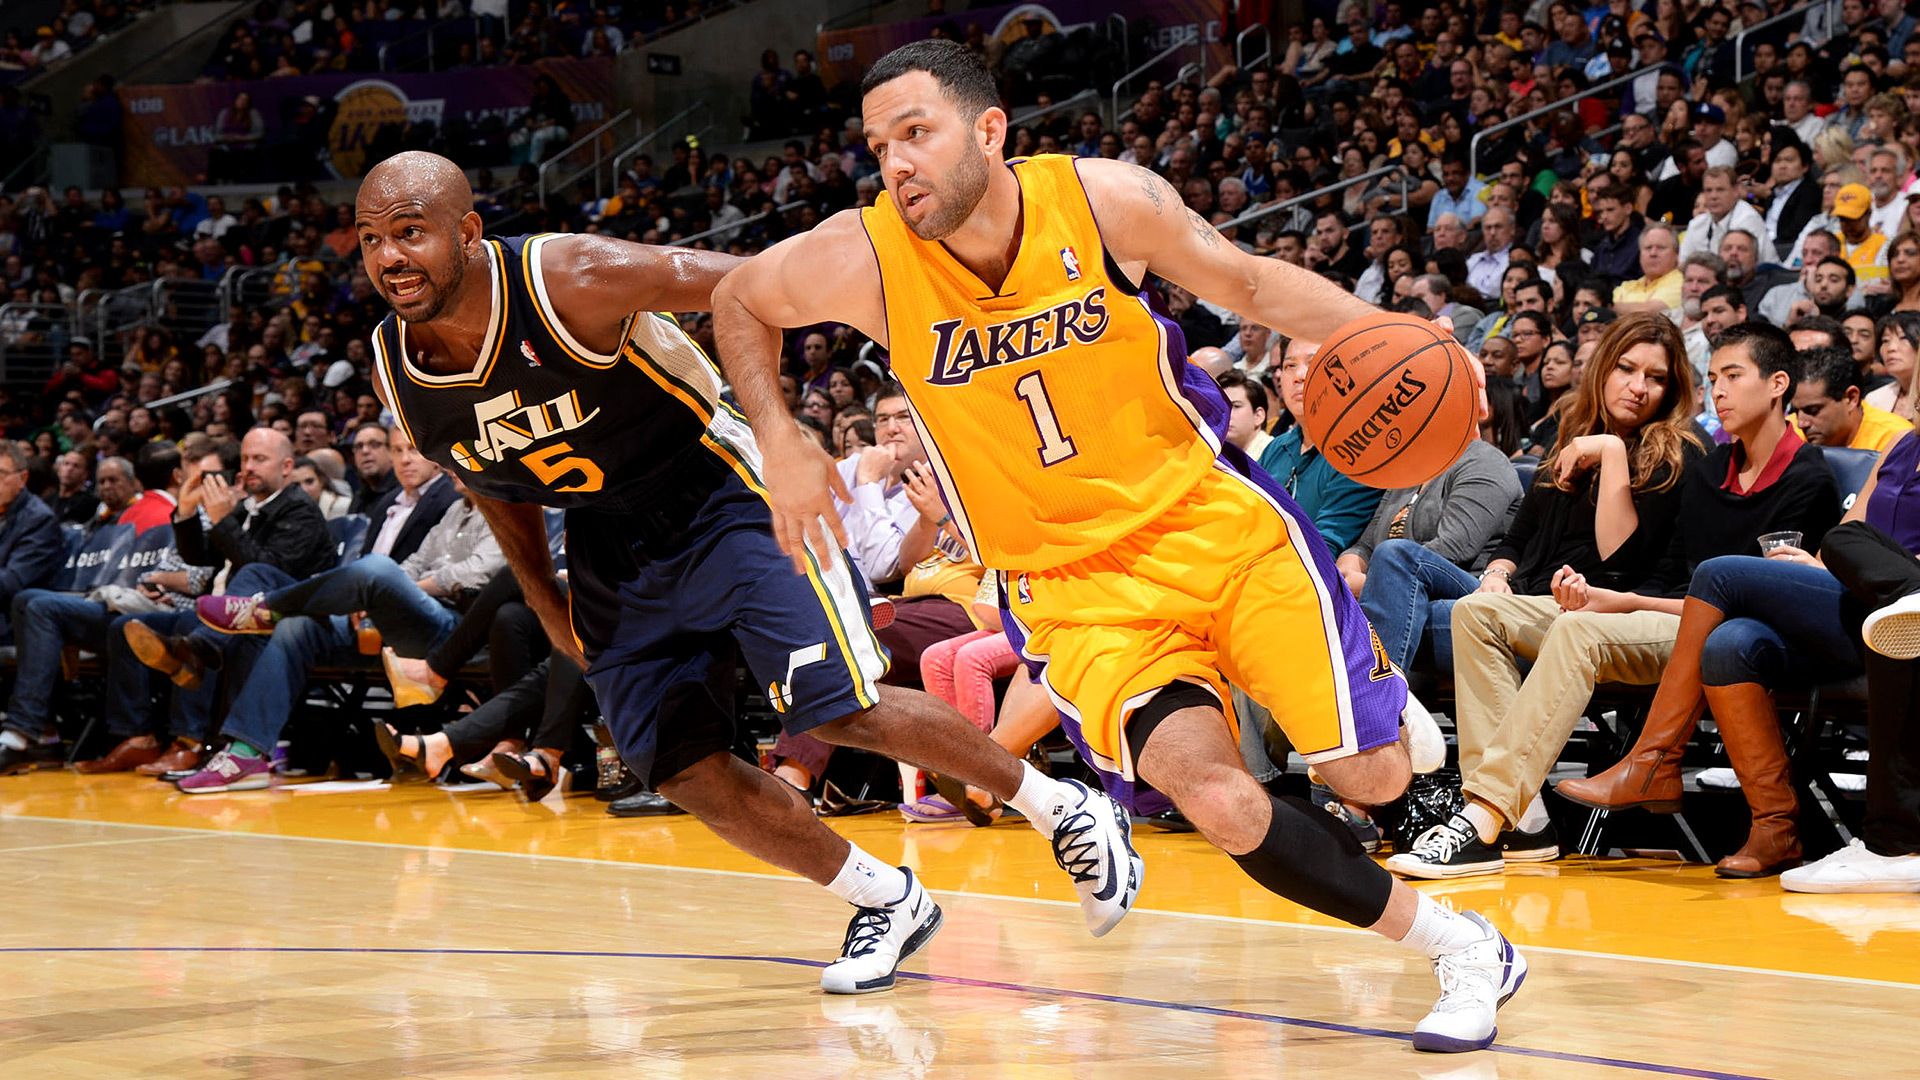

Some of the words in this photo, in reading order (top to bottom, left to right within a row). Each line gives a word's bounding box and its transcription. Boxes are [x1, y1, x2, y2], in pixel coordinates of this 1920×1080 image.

[924, 287, 1110, 387] LAKERS
[450, 389, 601, 472] JAZZ
[1014, 370, 1079, 468] 1
[1330, 369, 1426, 466] SPALDING
[519, 441, 605, 493] 5
